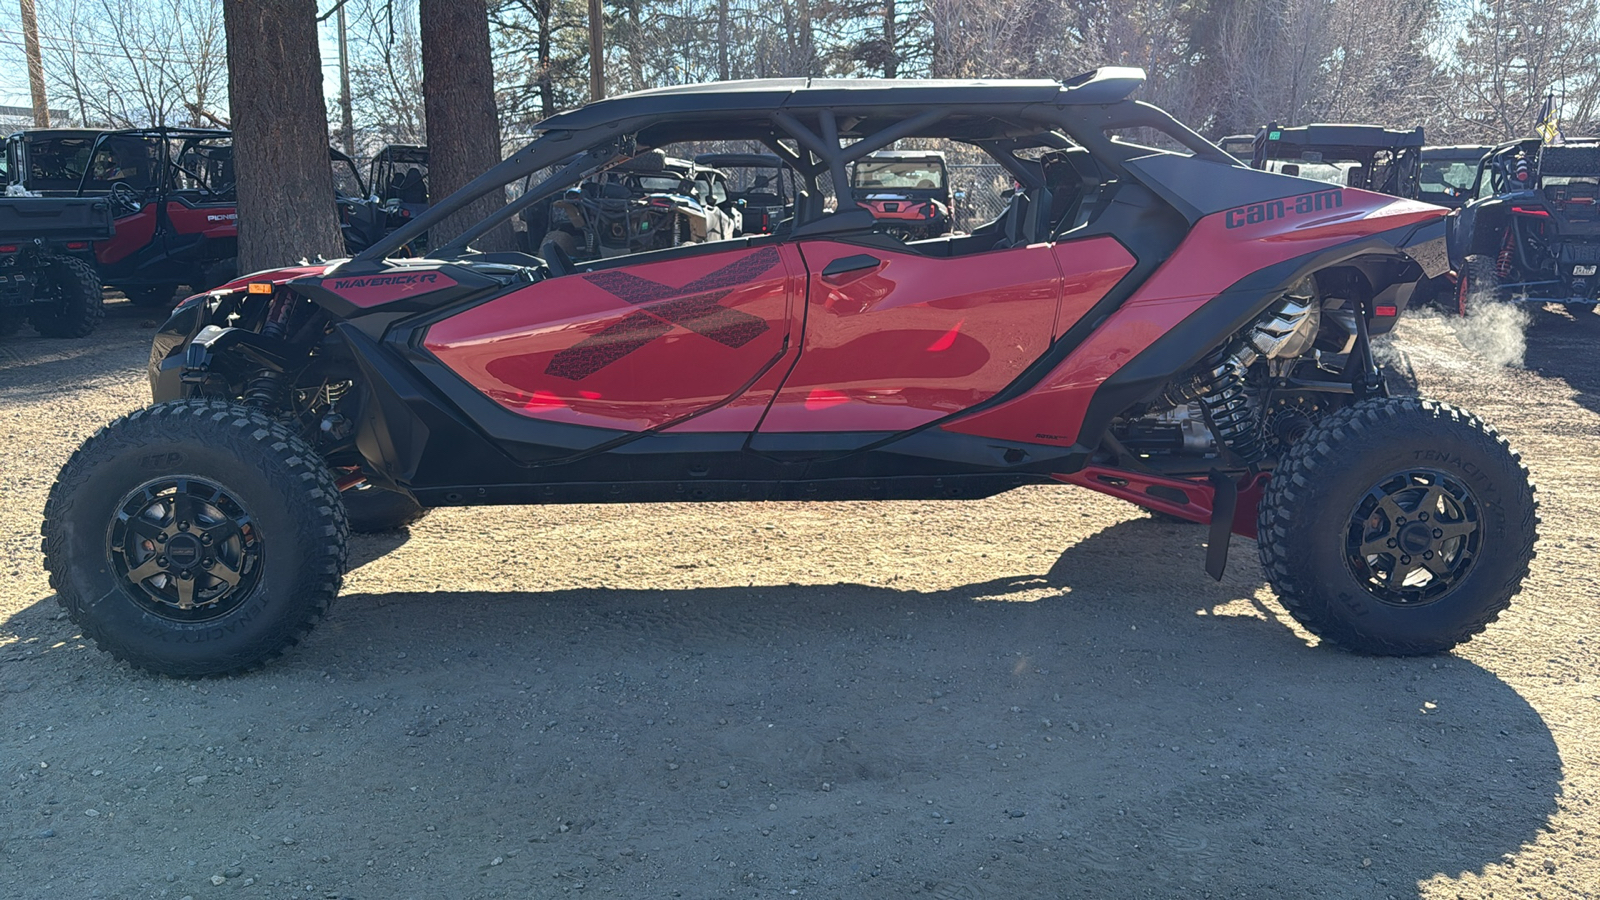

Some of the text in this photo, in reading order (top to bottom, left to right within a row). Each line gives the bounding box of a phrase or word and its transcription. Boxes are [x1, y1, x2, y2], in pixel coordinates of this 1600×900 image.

[1225, 189, 1343, 229] can-am
[334, 274, 438, 289] MAVERICK R
[140, 451, 183, 468] ITP
[1413, 449, 1496, 493] TENACITY
[175, 595, 270, 644] TENACITY
